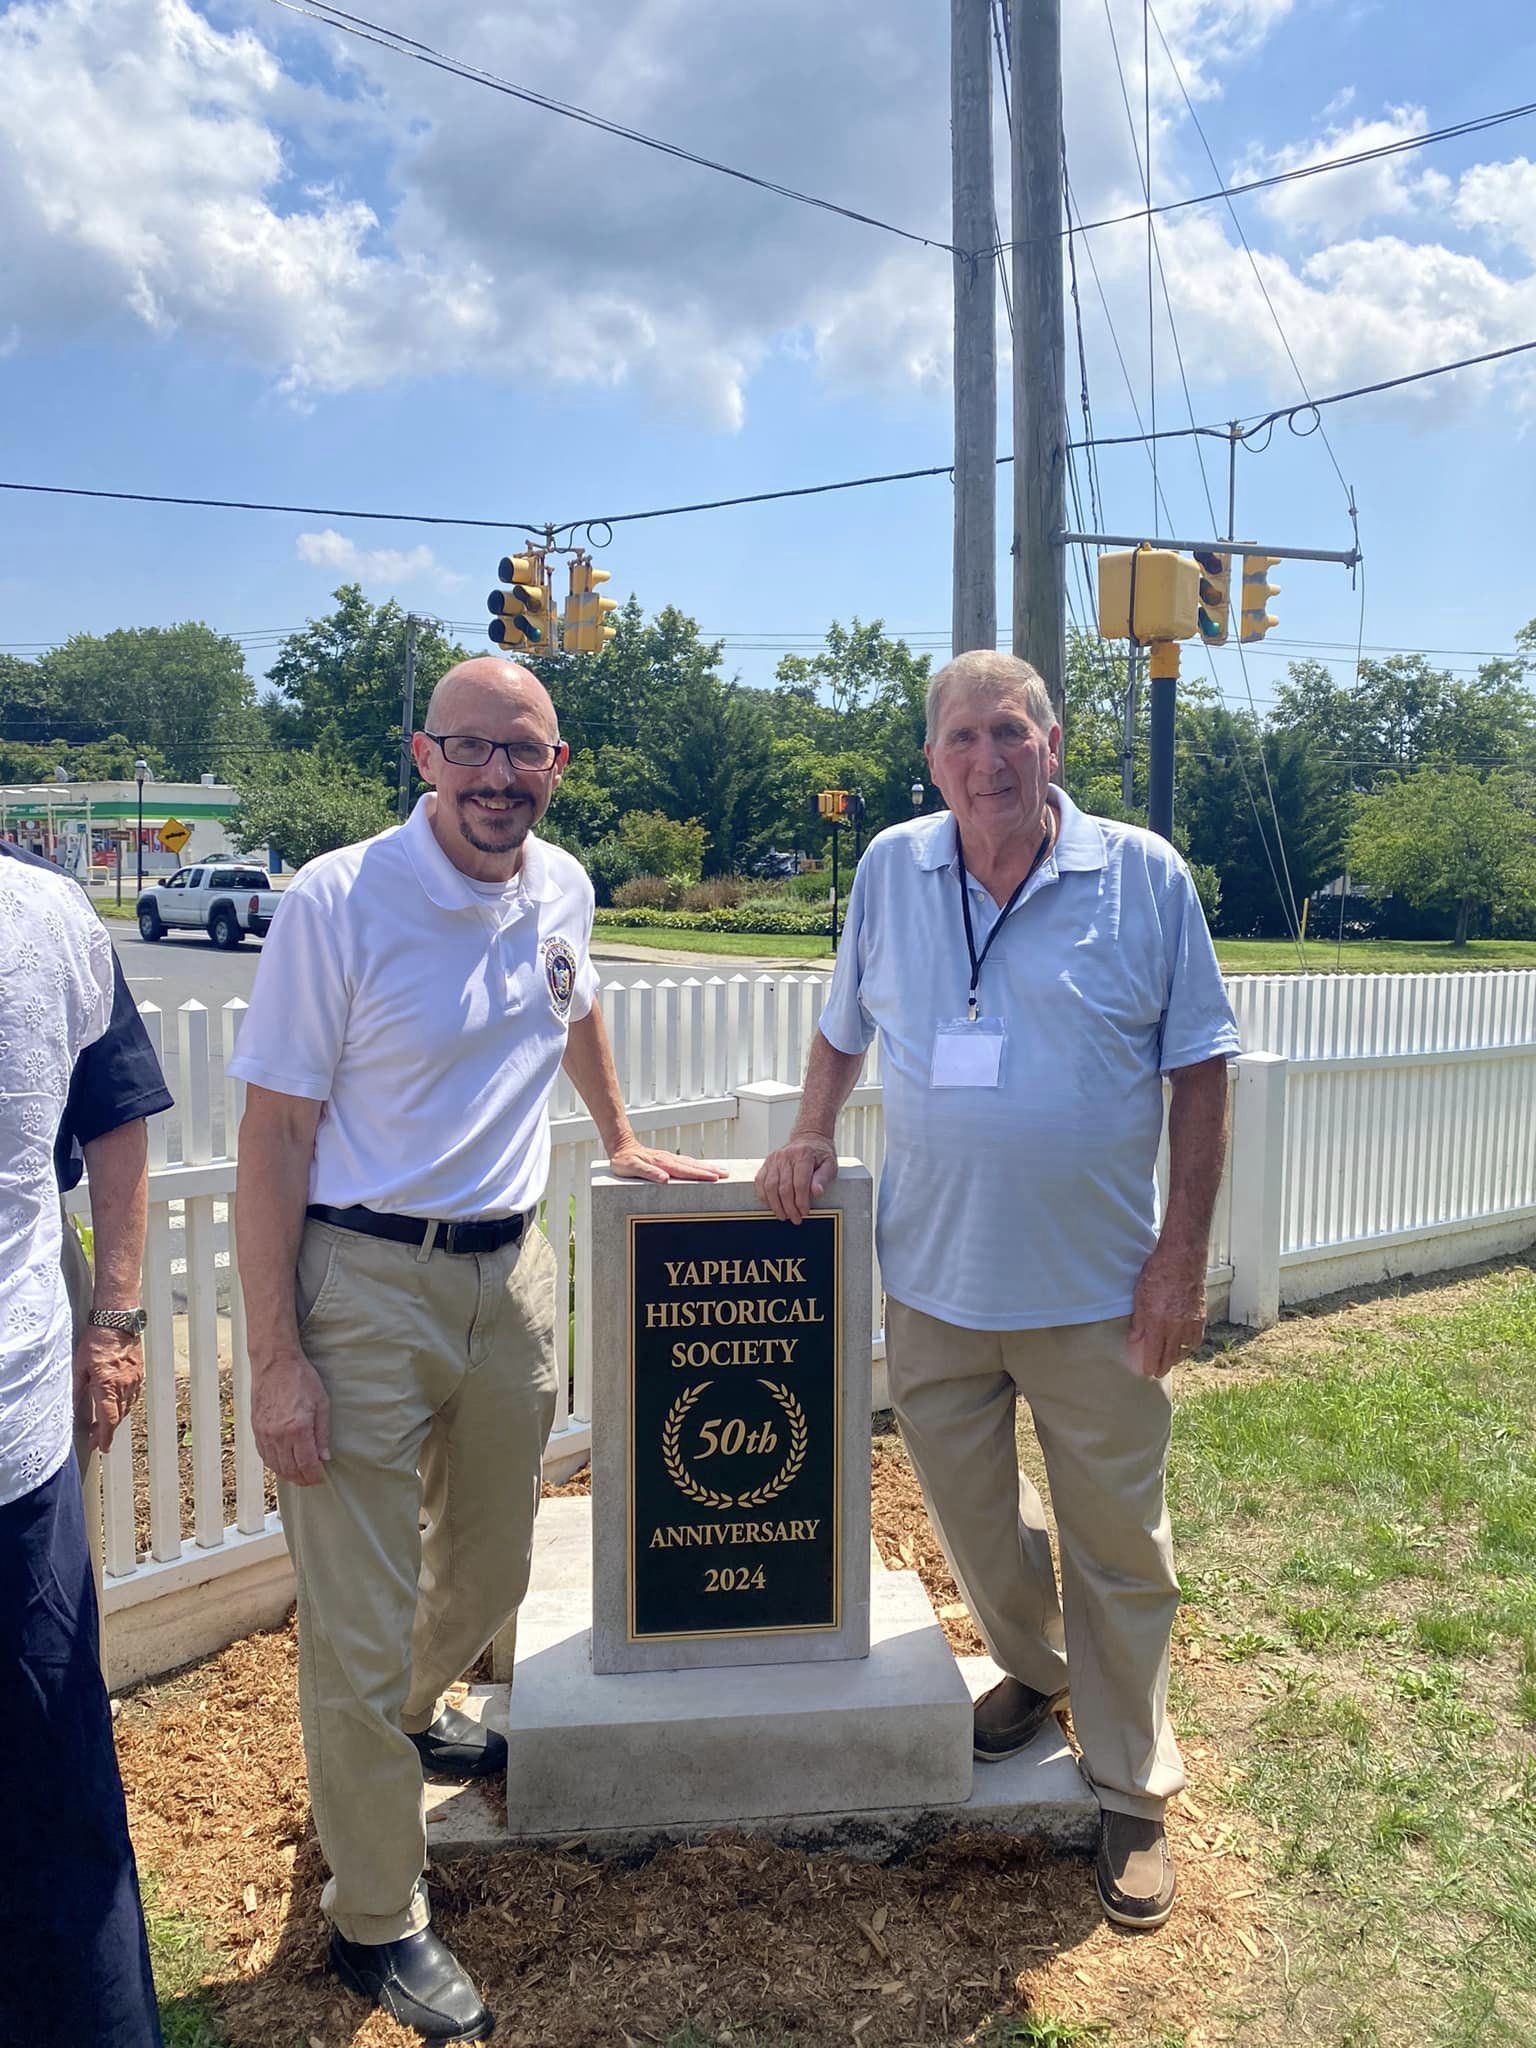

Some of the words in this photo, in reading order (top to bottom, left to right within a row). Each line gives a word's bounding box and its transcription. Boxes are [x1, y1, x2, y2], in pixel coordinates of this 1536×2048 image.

[664, 1259, 806, 1285] YAPHANK
[646, 1299, 824, 1327] HISTORICAL
[672, 1339, 798, 1367] SOCIETY
[694, 1419, 777, 1459] 50th
[650, 1520, 819, 1547] ANNIVERSARY
[705, 1565, 766, 1591] 2024
